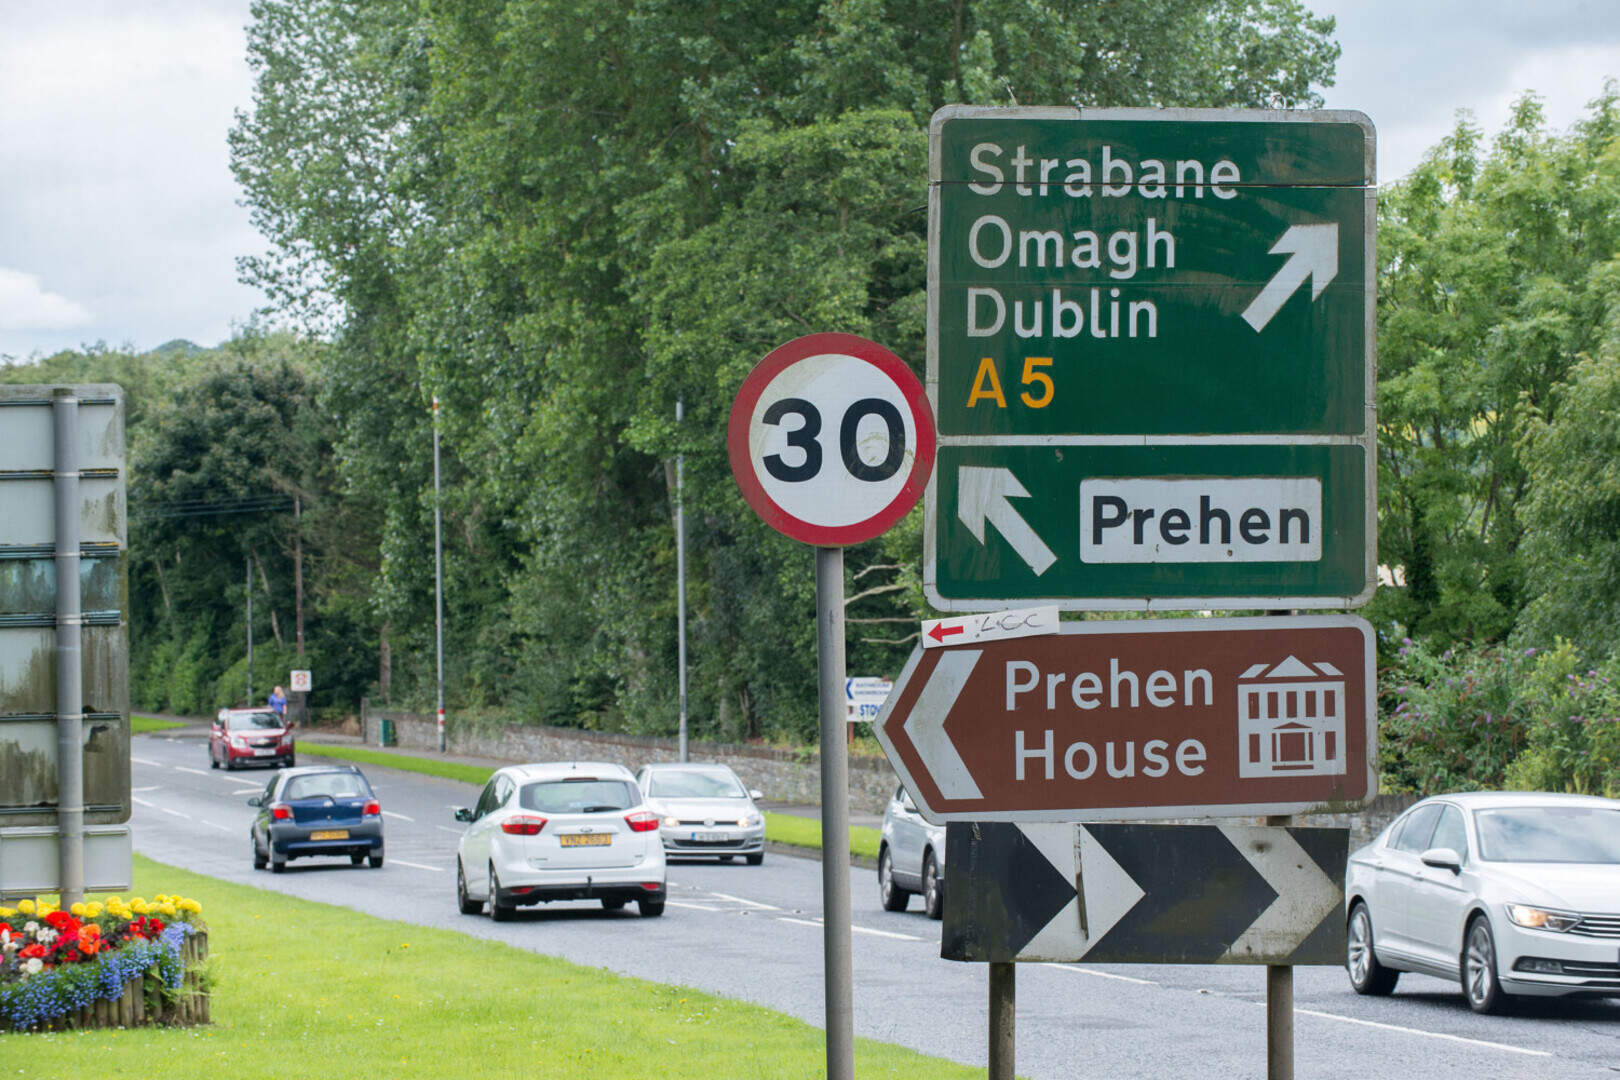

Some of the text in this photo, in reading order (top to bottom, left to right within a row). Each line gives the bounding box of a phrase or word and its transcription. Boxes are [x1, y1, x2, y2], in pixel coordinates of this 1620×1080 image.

[969, 143, 1240, 199] Strabane
[969, 215, 1174, 279] Omagh
[968, 288, 1156, 337] Dublin
[762, 398, 906, 482] 30
[1093, 496, 1310, 545] Prehen
[1006, 659, 1212, 710] Prehen
[1016, 730, 1206, 780] House
